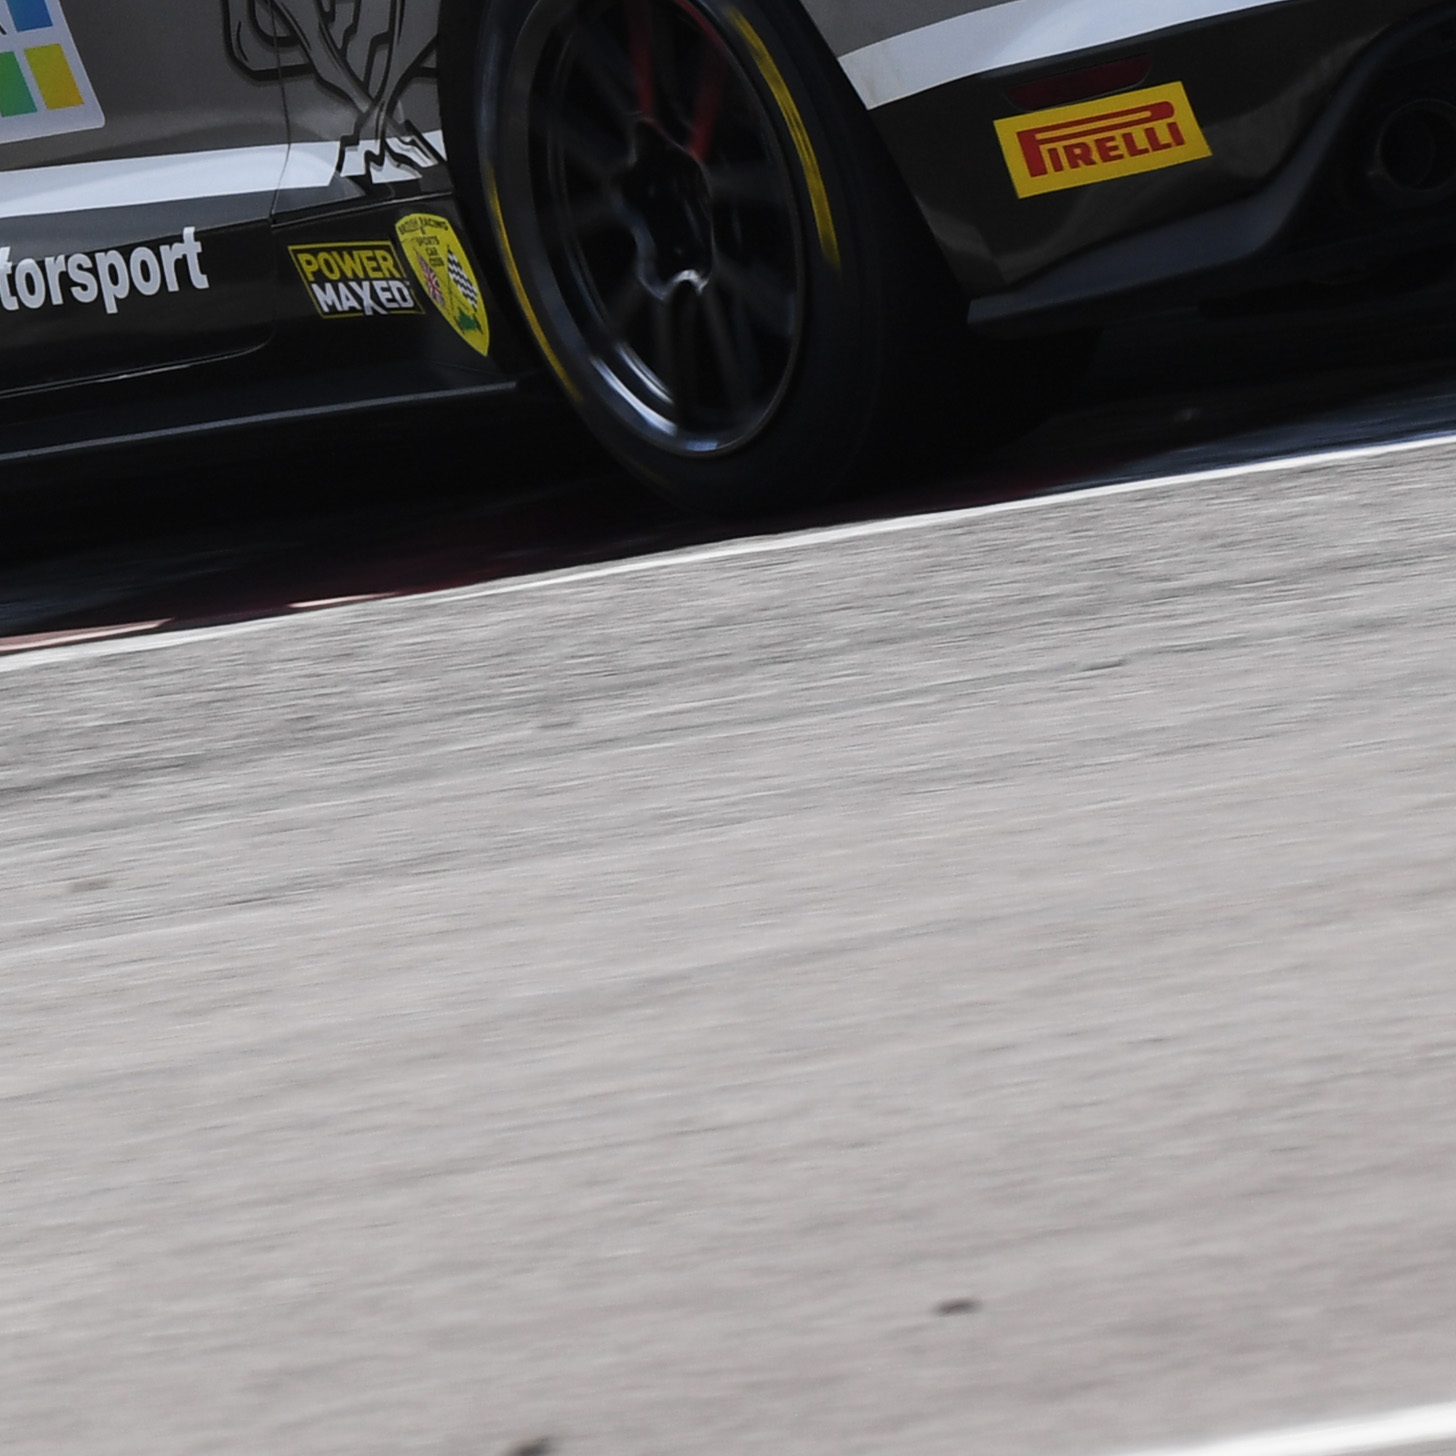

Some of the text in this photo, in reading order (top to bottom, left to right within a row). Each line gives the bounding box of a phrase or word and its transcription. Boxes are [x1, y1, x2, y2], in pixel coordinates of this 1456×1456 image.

[1016, 100, 1185, 178] PIRELLI
[297, 250, 402, 281] POWER
[311, 280, 414, 315] MAXED
